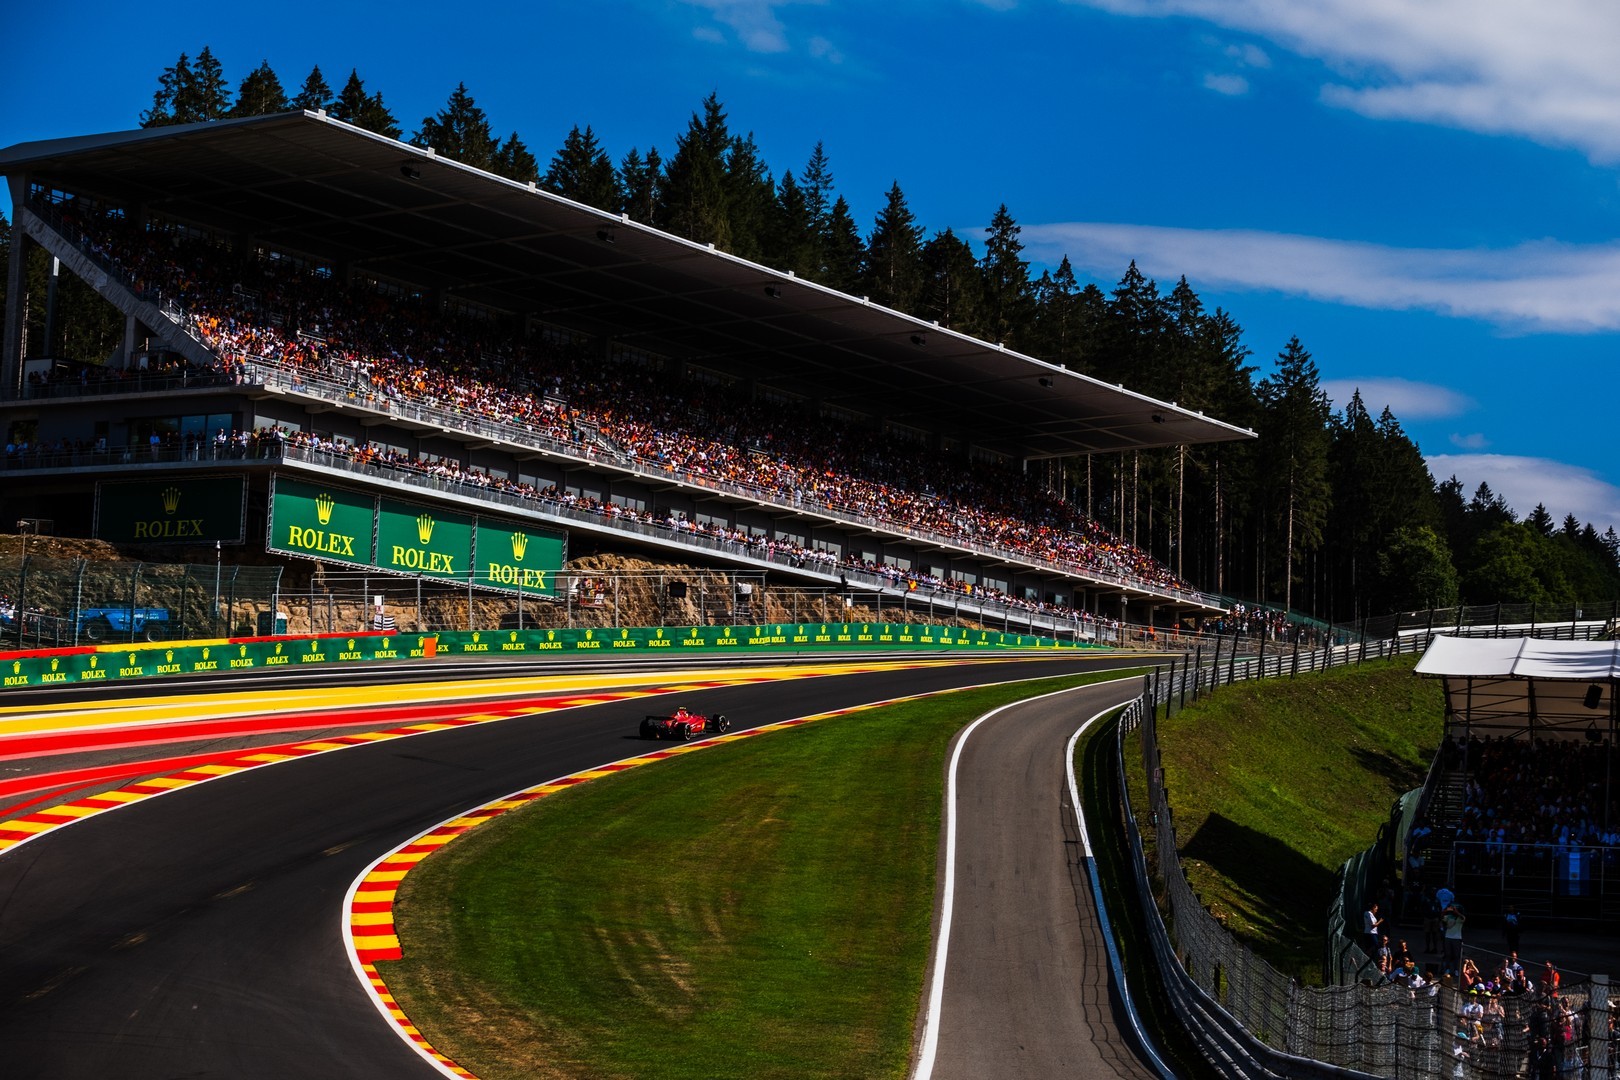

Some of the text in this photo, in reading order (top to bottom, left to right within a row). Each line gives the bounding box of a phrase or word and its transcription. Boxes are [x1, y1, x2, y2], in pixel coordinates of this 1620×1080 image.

[134, 519, 204, 538] ROLEX
[288, 526, 355, 557] ROLEX
[391, 545, 454, 575] ROLEX
[488, 562, 547, 590] ROLEX
[502, 642, 525, 651] ROLEX
[539, 641, 563, 650] ROLEX
[577, 640, 601, 649] ROLEX
[613, 640, 636, 648] ROLEX
[648, 639, 671, 647] ROLEX
[683, 638, 705, 646] ROLEX
[716, 638, 738, 646] ROLEX
[410, 648, 425, 657] ROL
[464, 643, 489, 652] ROLEX
[302, 653, 326, 663] ROLEX
[338, 651, 362, 661] ROLEX
[374, 649, 398, 659] ROLEX
[230, 658, 254, 668] ROLEX
[266, 655, 290, 665] ROLEX
[156, 663, 181, 674] ROLEX
[194, 660, 218, 671] ROLEX
[81, 669, 107, 680] ROLEX
[119, 666, 144, 677] ROLEX
[3, 675, 29, 686] ROLEX
[41, 672, 67, 683] ROLEX
